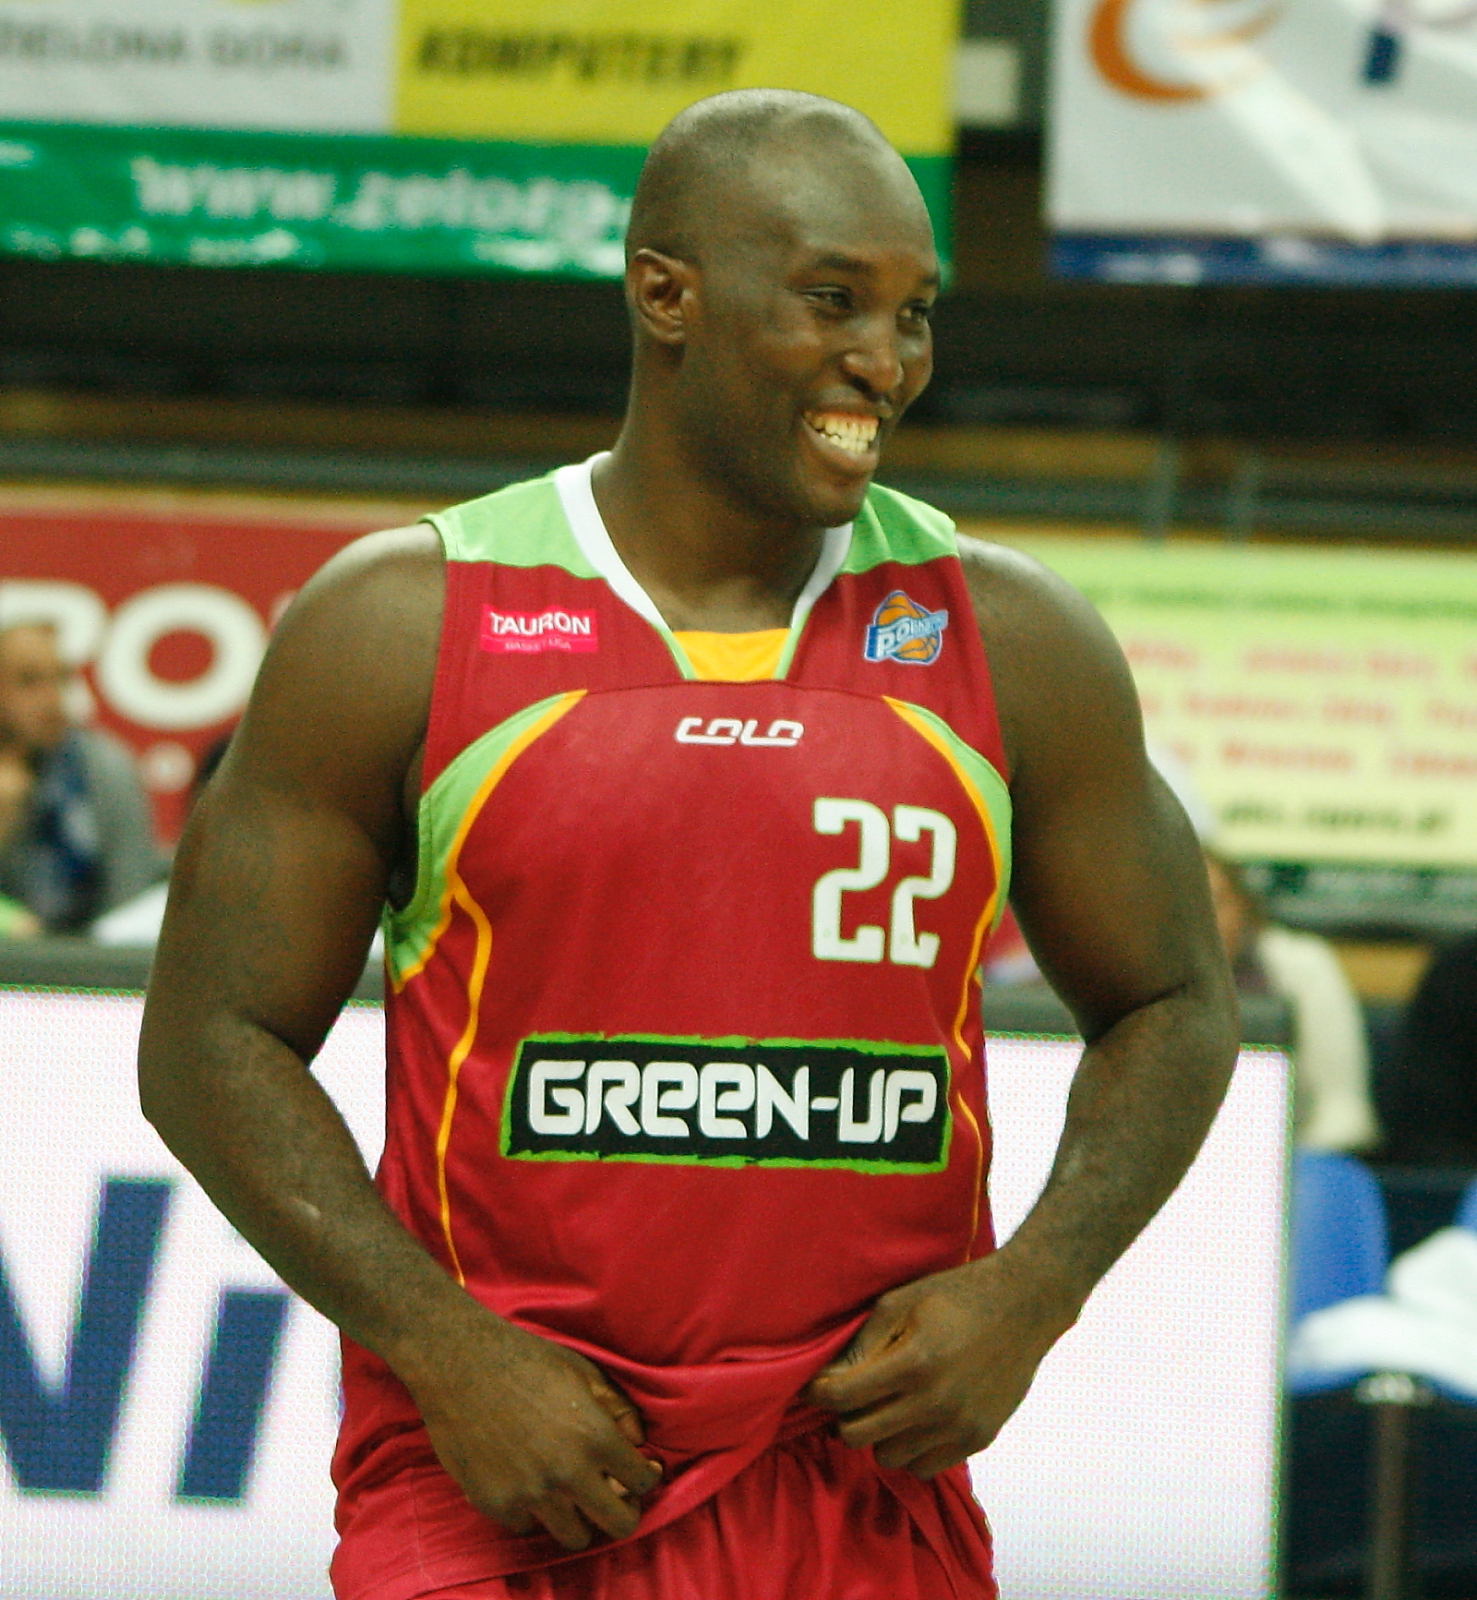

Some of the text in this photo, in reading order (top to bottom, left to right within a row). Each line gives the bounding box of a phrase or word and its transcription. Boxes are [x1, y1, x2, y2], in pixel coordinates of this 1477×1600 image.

[490, 611, 591, 636] TAURON
[675, 716, 805, 747] COLO
[812, 797, 957, 969] 22
[528, 1060, 938, 1143] GREEN-UP
